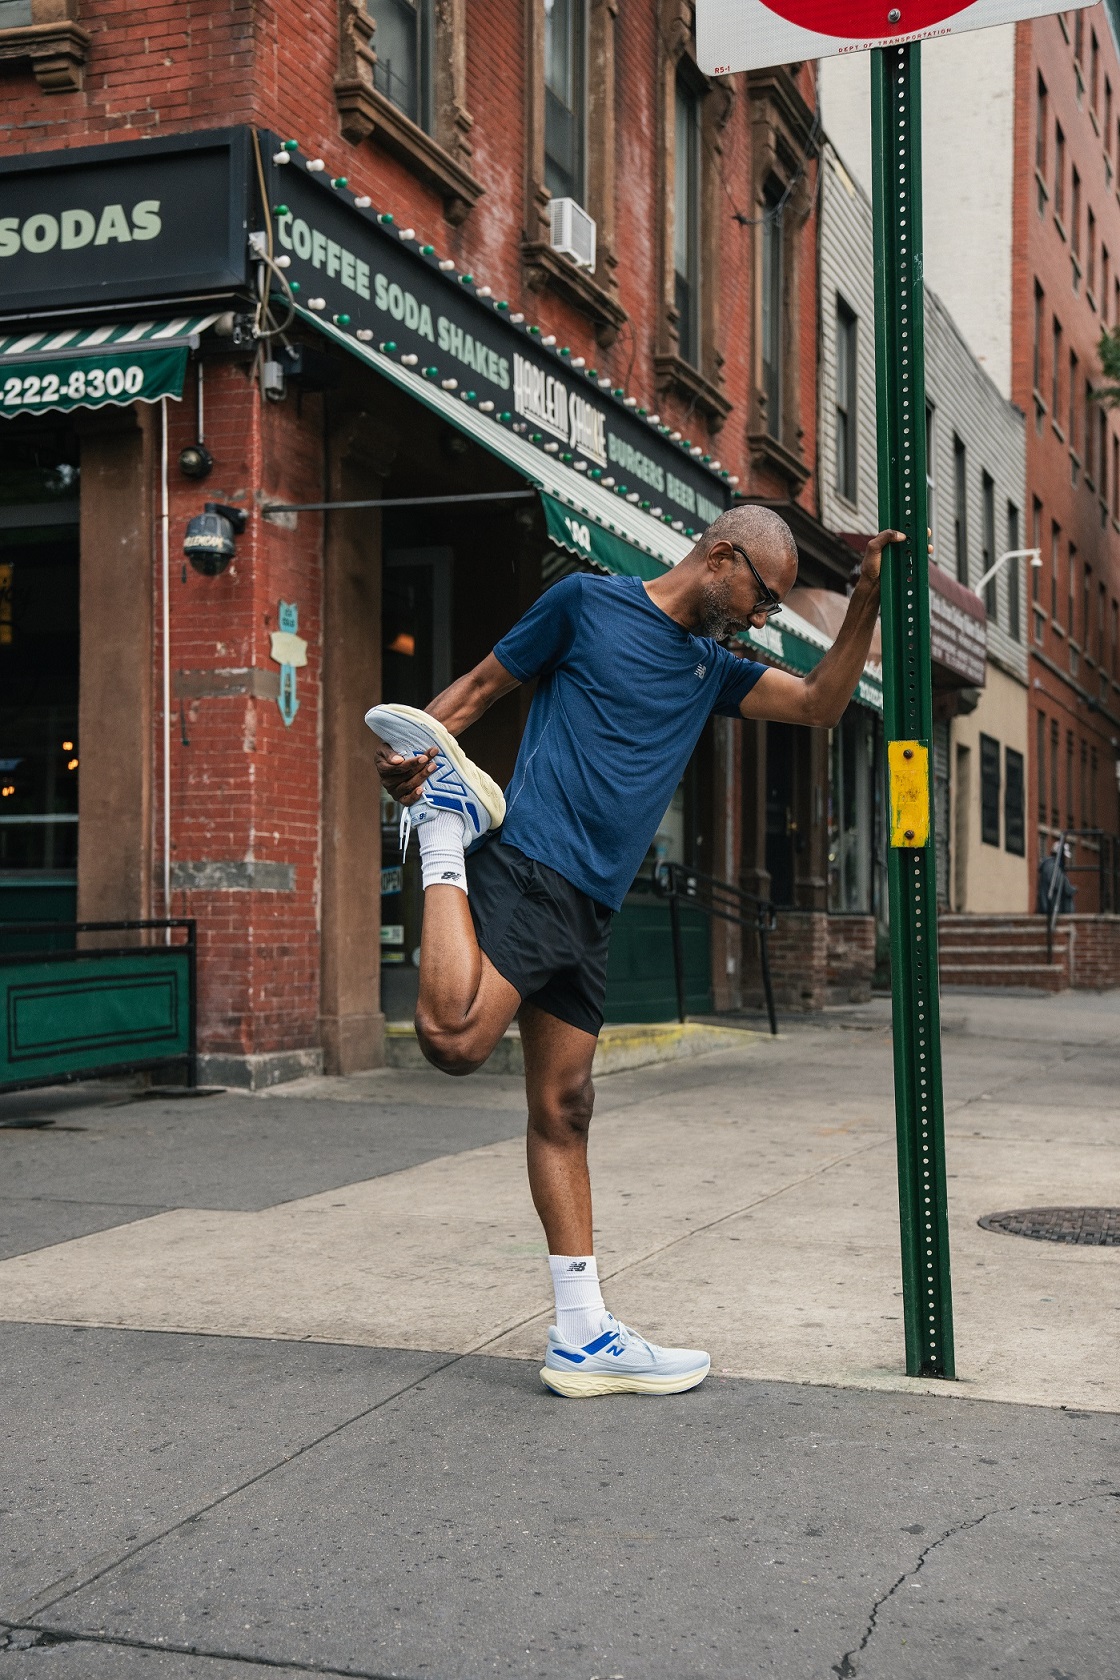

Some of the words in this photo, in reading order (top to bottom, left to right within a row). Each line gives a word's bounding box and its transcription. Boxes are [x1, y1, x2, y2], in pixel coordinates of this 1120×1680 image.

[838, 44, 859, 53] DEPT
[878, 28, 952, 46] TRANSPORTATION
[0, 200, 162, 257] SODAS
[277, 211, 371, 300] COFFEE
[374, 273, 435, 343] SODA
[437, 316, 510, 390] SHAKES
[513, 352, 568, 444] HARLEM
[568, 391, 607, 469] SHAKE
[608, 432, 665, 493] BURGERS
[666, 472, 696, 514] BEER
[566, 1261, 587, 1272] NB
[605, 1345, 625, 1358] N
